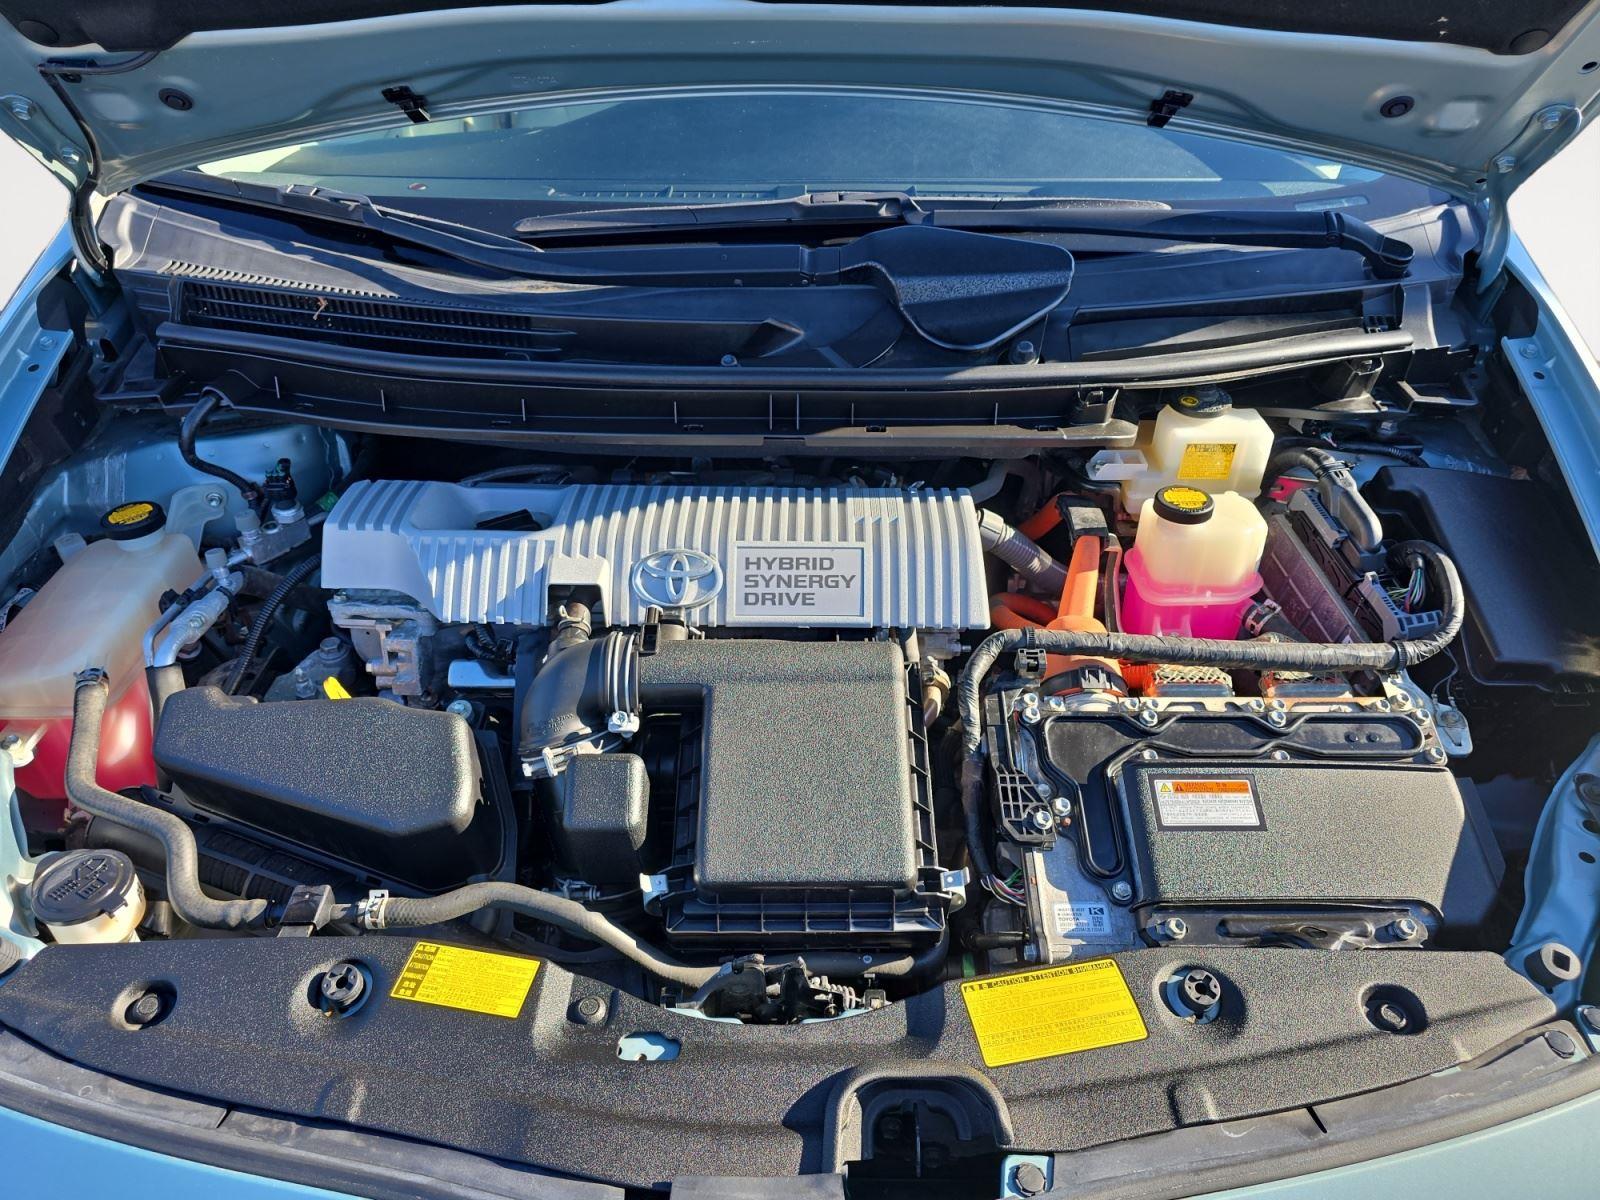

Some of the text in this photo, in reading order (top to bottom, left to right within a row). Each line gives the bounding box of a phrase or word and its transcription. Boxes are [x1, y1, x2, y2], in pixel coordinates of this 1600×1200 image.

[745, 557, 834, 571] HYBRID
[744, 574, 856, 589] SYNERGY
[744, 592, 815, 606] DRIVE
[992, 969, 1069, 986] CAUTION ATTENTION
